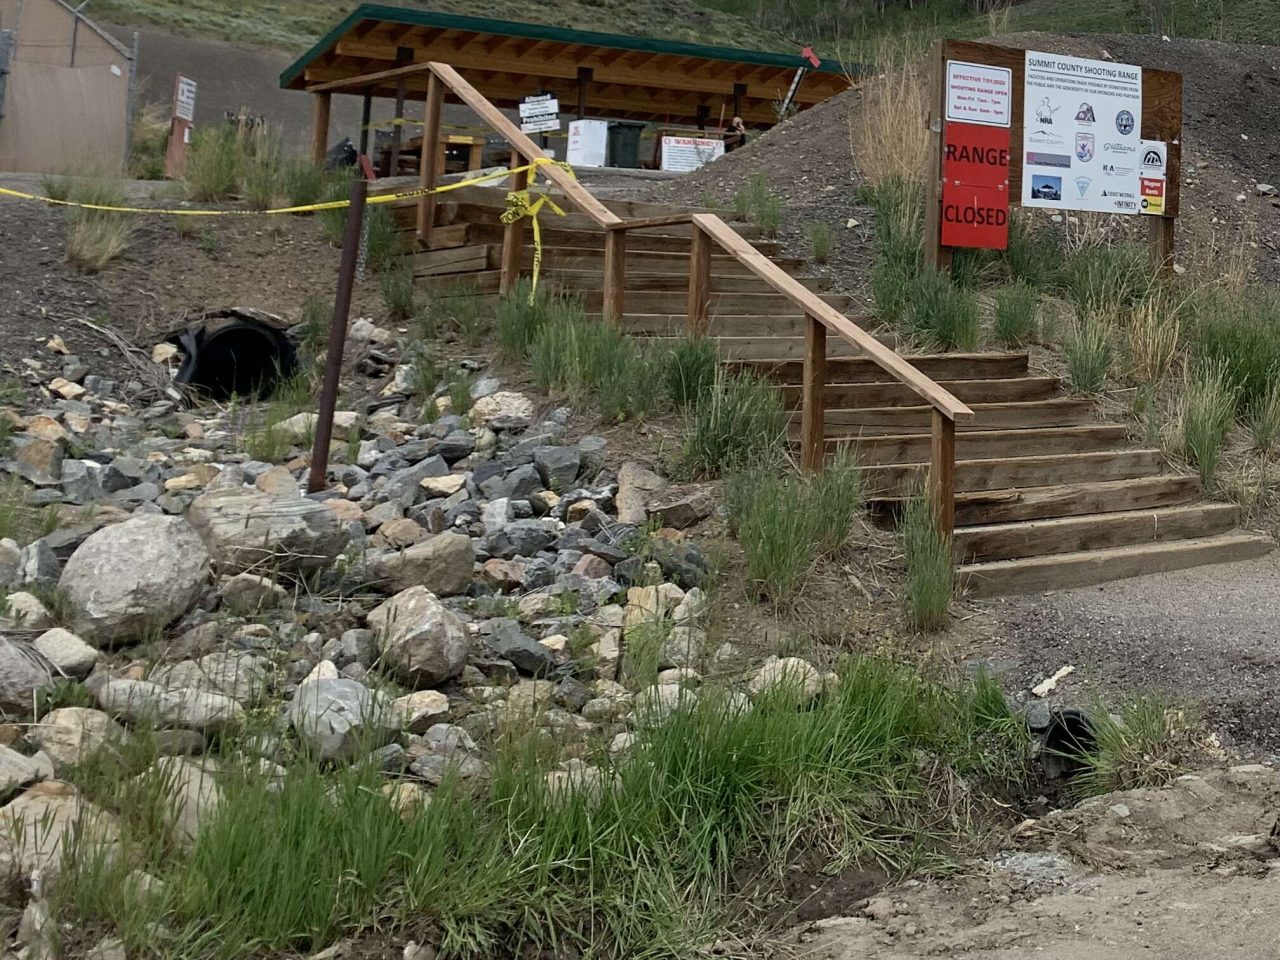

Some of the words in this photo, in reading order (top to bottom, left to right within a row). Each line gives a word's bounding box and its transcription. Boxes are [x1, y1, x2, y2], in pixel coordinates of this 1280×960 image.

[1028, 58, 1056, 69] SUMMIT
[1057, 62, 1083, 73] COUNTY
[1084, 66, 1117, 78] SHOOTING
[1118, 71, 1138, 80] RANGE
[525, 93, 551, 103] Allowed
[522, 114, 557, 124] Prohibited
[947, 143, 1008, 167] RANGE
[944, 204, 1006, 227] CLOSED
